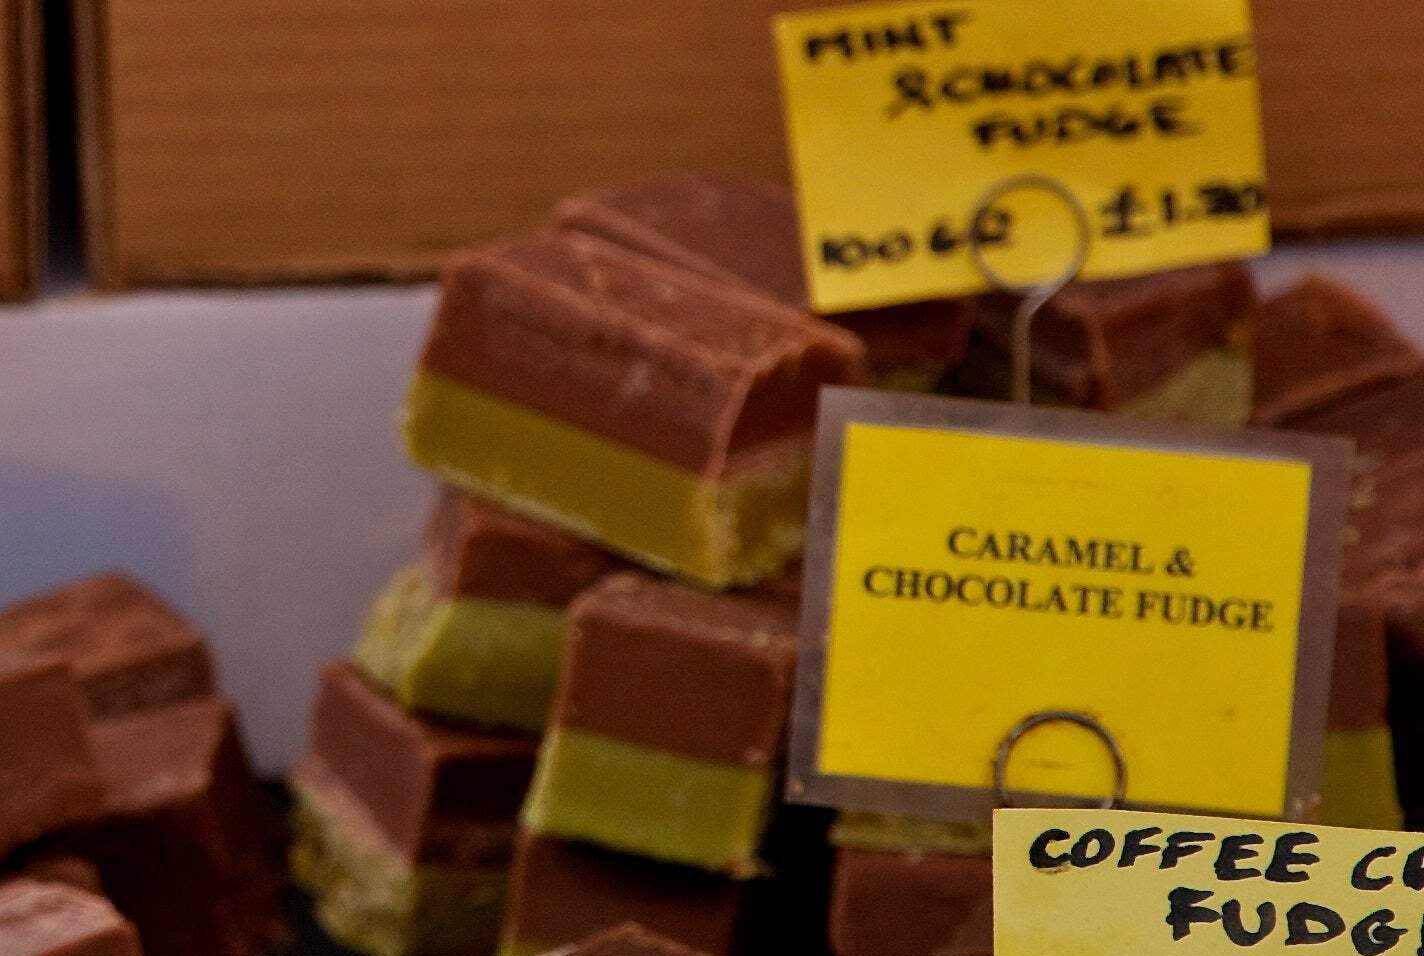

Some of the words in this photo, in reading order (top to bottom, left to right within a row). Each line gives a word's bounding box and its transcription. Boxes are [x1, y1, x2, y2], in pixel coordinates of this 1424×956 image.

[804, 12, 964, 61] MINT
[973, 99, 1197, 147] FUDGE
[947, 525, 1156, 577] CARAMEL
[1165, 547, 1196, 578] &
[863, 566, 1124, 620] CHOCOLATE
[1134, 589, 1275, 634] FUDGE
[1028, 826, 1321, 883] COFFEE
